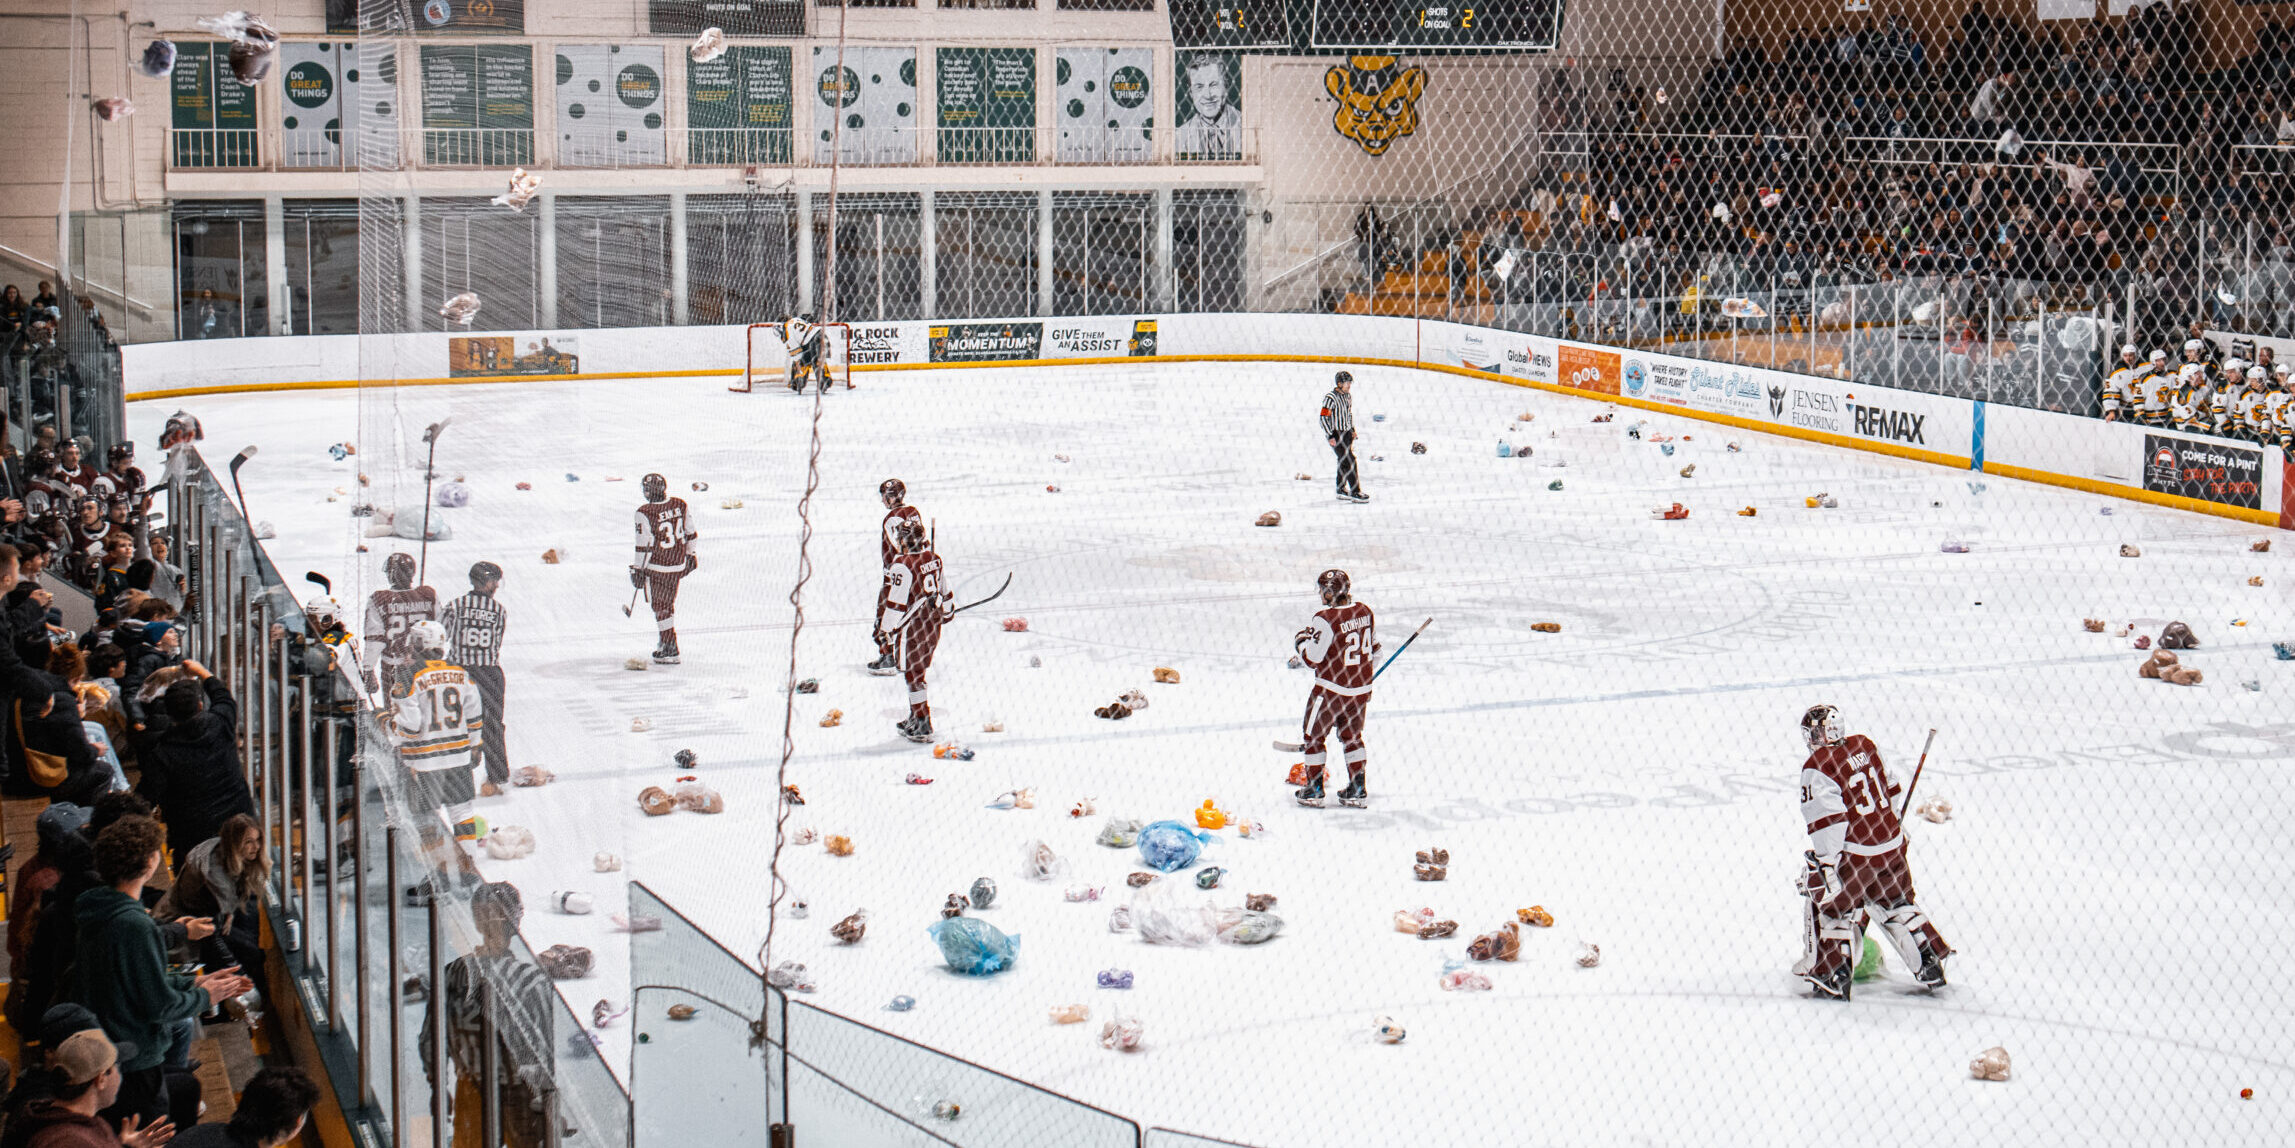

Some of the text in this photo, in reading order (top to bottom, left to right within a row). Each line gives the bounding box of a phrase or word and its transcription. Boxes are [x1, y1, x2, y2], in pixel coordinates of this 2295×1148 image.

[1237, 9, 1244, 28] 2
[1420, 8, 1474, 28] 1 SHOTS 2
[1424, 20, 1450, 29] ON GOAL
[290, 71, 304, 80] DO
[621, 73, 634, 82] DO
[823, 74, 835, 82] DO
[290, 80, 323, 89] GREAT
[621, 81, 651, 90] GREAT
[1114, 83, 1141, 91] GREAT
[290, 89, 328, 99] THINGS
[621, 89, 655, 98] THINGS
[1115, 91, 1146, 99] THINGS
[866, 328, 899, 339] ROCK
[1052, 329, 1081, 340] GIVE
[948, 338, 1028, 351] MOMENTUM
[1058, 339, 1122, 352] AN ASSIST
[1507, 350, 1529, 364] Global
[1532, 355, 1552, 368] NEWS
[1669, 366, 1688, 377] HISTORY
[1654, 375, 1667, 386] TAKES
[1690, 366, 1761, 397] Silent Rides
[1792, 389, 1839, 413] JENSEN
[1792, 411, 1839, 432] FLOORING
[2182, 450, 2257, 471] COME FOR A PINT
[2183, 468, 2225, 481] STAY FOR
[2152, 478, 2176, 487] WHYTE
[2209, 481, 2258, 496] THE PARTY
[659, 518, 686, 549] 34
[460, 608, 498, 624] LAFORGE
[462, 627, 492, 648] 168
[1344, 627, 1373, 666] 24
[416, 672, 465, 691] McGREGOR
[426, 686, 463, 732] 19
[1847, 752, 1870, 771] WARD
[1801, 784, 1813, 803] 31
[1848, 766, 1889, 816] 31
